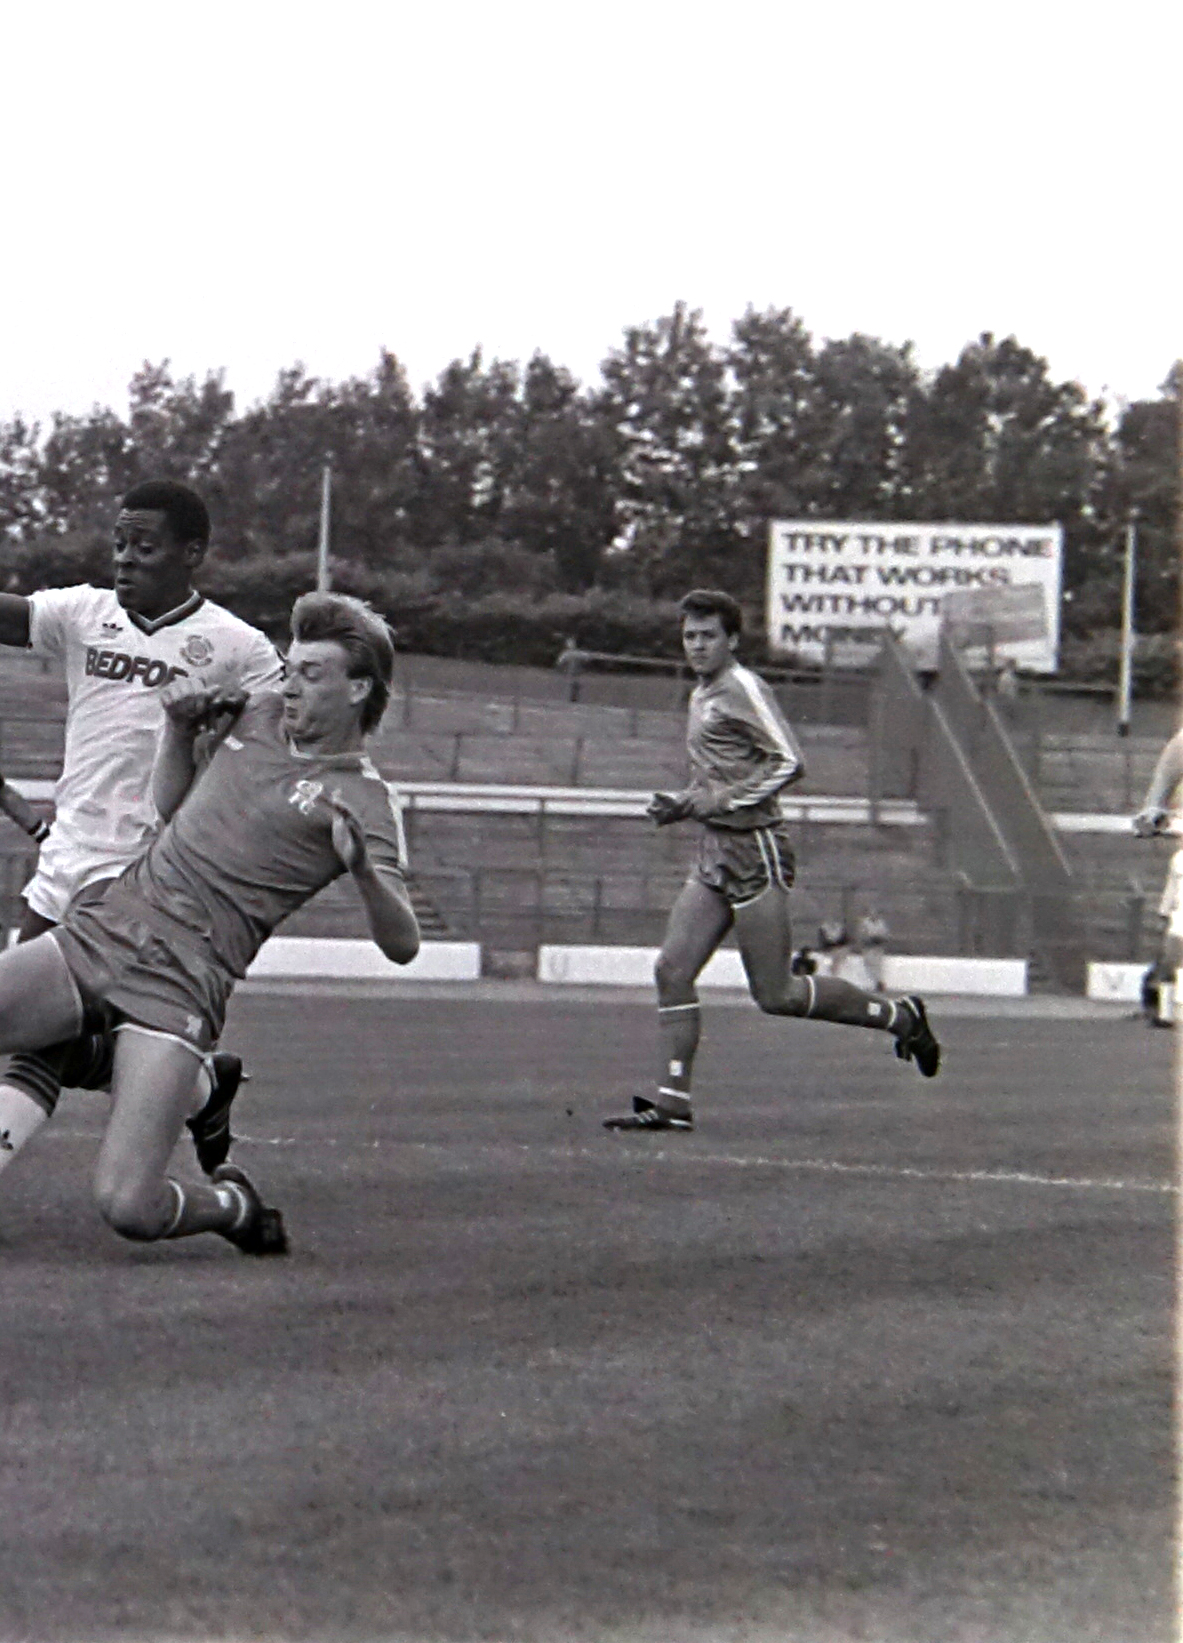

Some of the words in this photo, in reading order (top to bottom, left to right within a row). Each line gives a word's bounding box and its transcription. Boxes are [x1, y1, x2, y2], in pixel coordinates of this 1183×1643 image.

[783, 533, 849, 554] TRY
[857, 534, 921, 557] THE
[928, 535, 1053, 558] PHONE
[783, 563, 868, 585] THAT
[876, 565, 1011, 586] WORKS
[780, 593, 942, 618] WITHOUT
[85, 647, 189, 688] BEDFO
